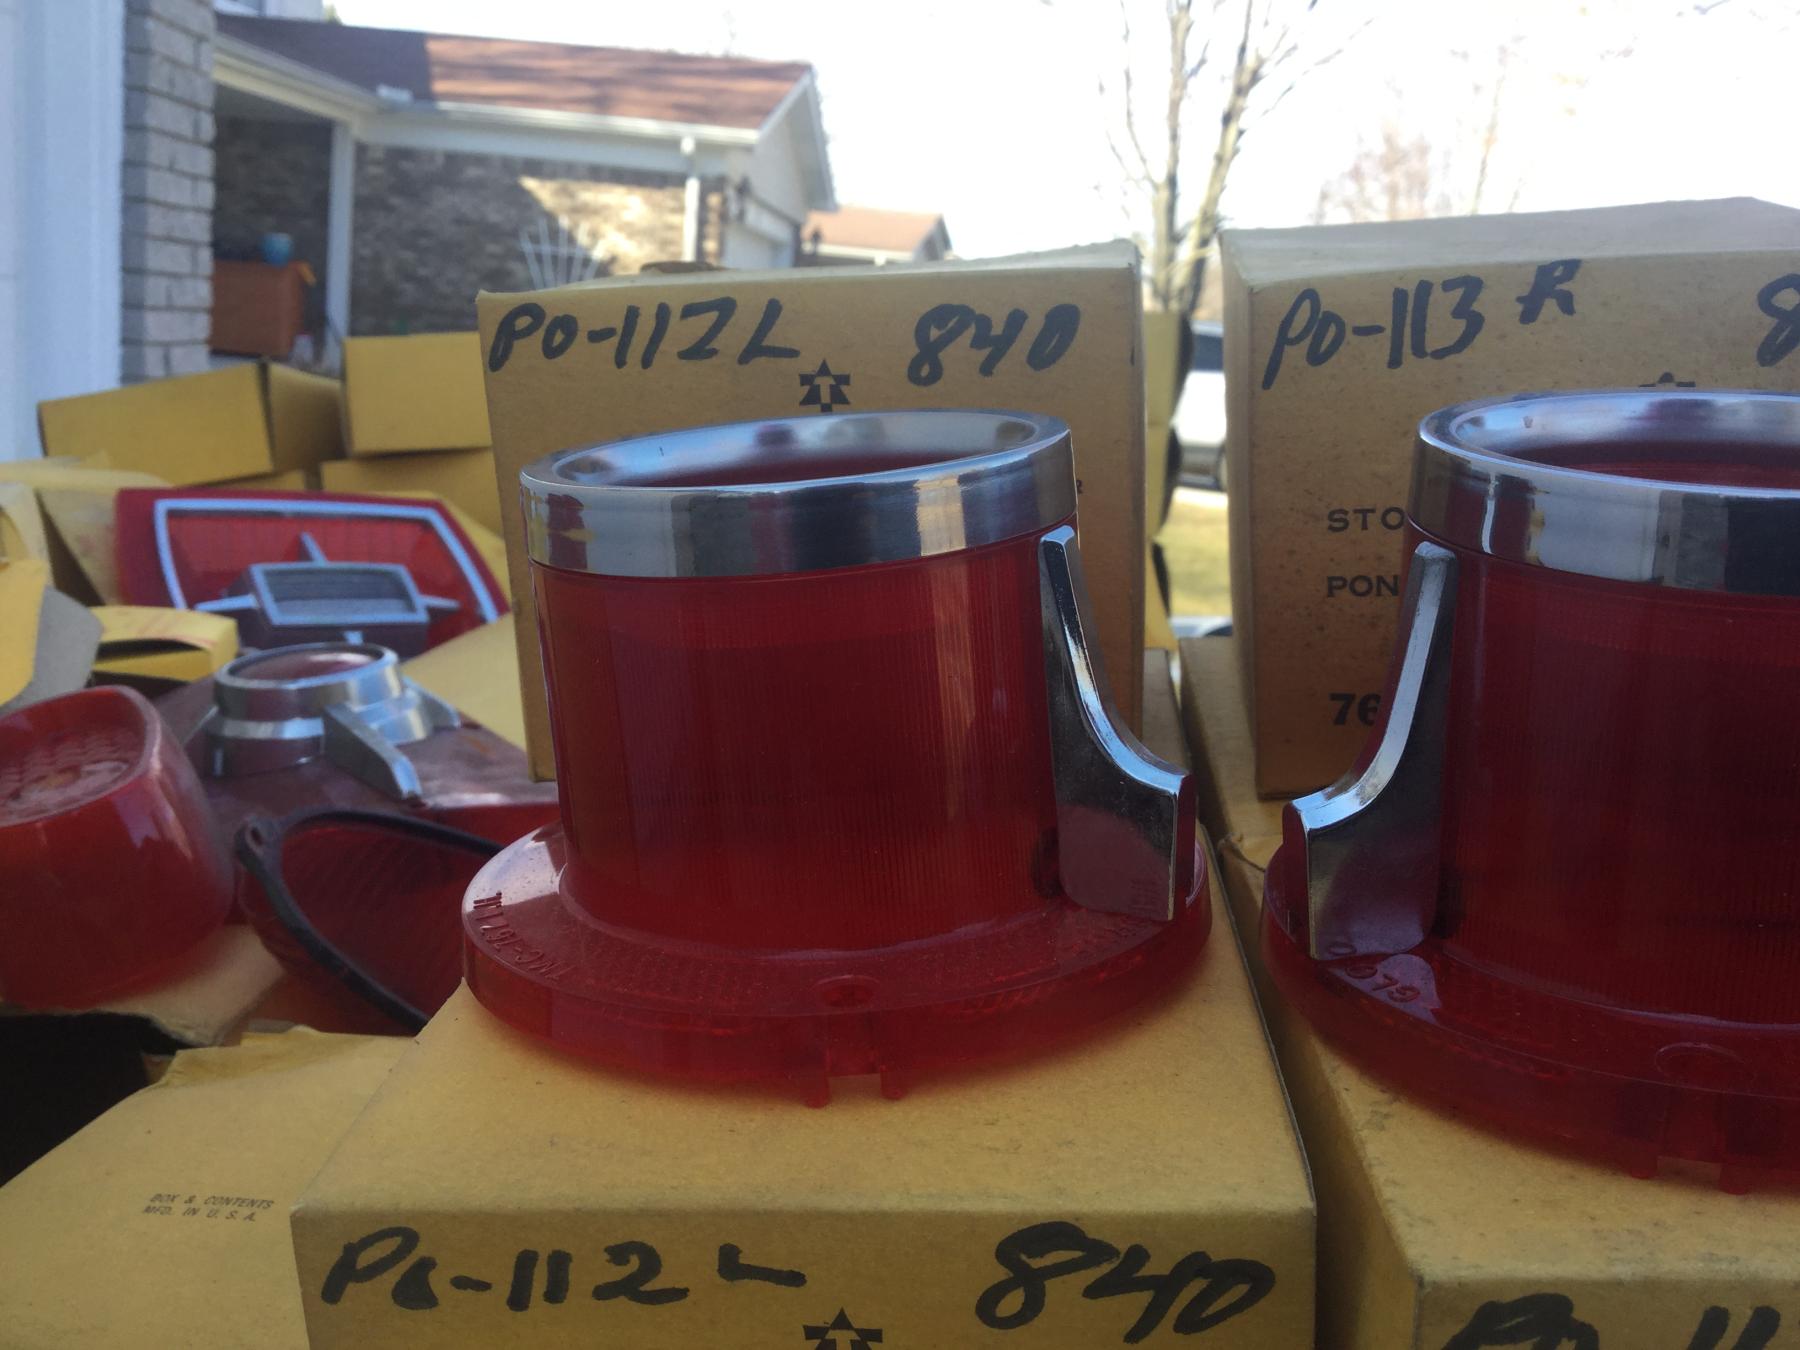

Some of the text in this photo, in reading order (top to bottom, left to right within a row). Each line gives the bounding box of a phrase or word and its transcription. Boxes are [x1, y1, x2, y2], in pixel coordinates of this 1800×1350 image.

[1515, 258, 1582, 324] R
[907, 303, 1081, 386] 840
[1326, 574, 1400, 598] PON
[204, 1195, 274, 1210] CONTENTS
[975, 1220, 1276, 1345] 840
